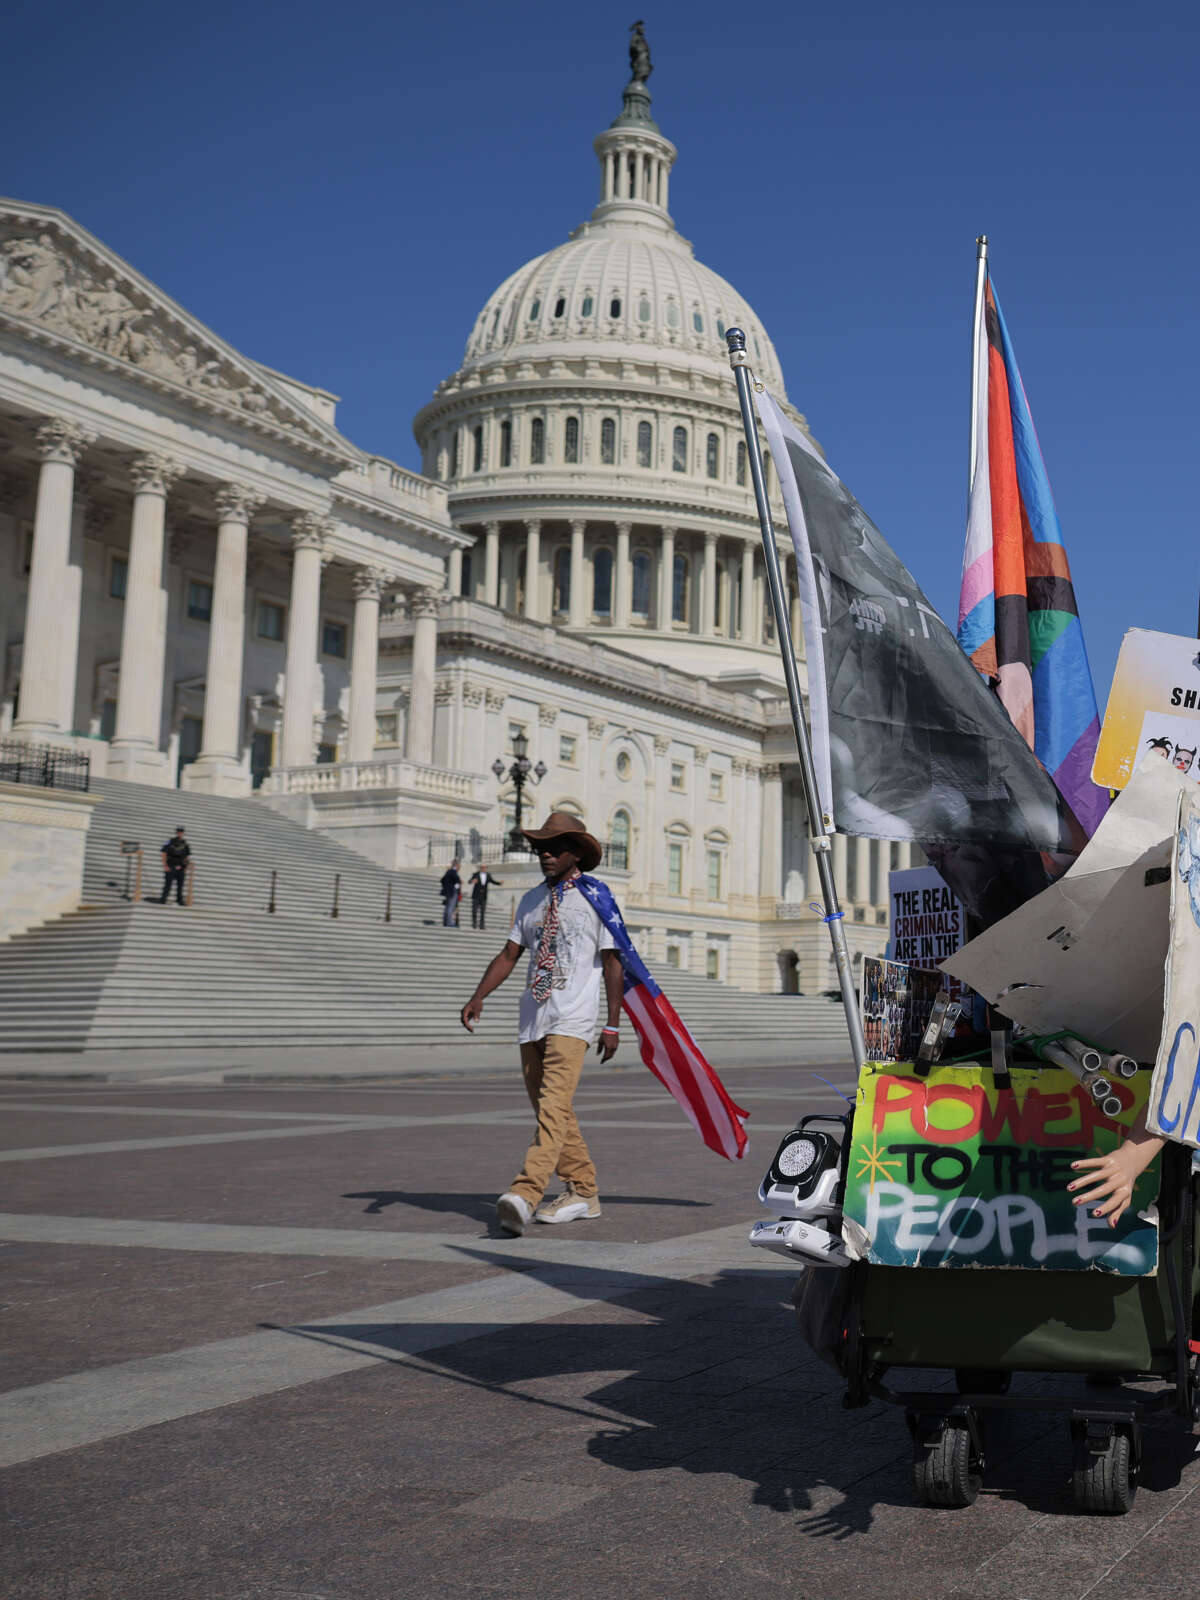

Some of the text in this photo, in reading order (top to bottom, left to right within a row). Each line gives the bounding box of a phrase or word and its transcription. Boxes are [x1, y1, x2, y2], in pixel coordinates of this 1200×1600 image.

[894, 887, 959, 916] THE REAL
[894, 912, 960, 938] CRIMINALS
[894, 934, 960, 960] ARE IN THE
[871, 1074, 1136, 1151] POWER
[888, 1143, 1087, 1191] TO THE
[860, 1181, 1147, 1262] PEOPLE
